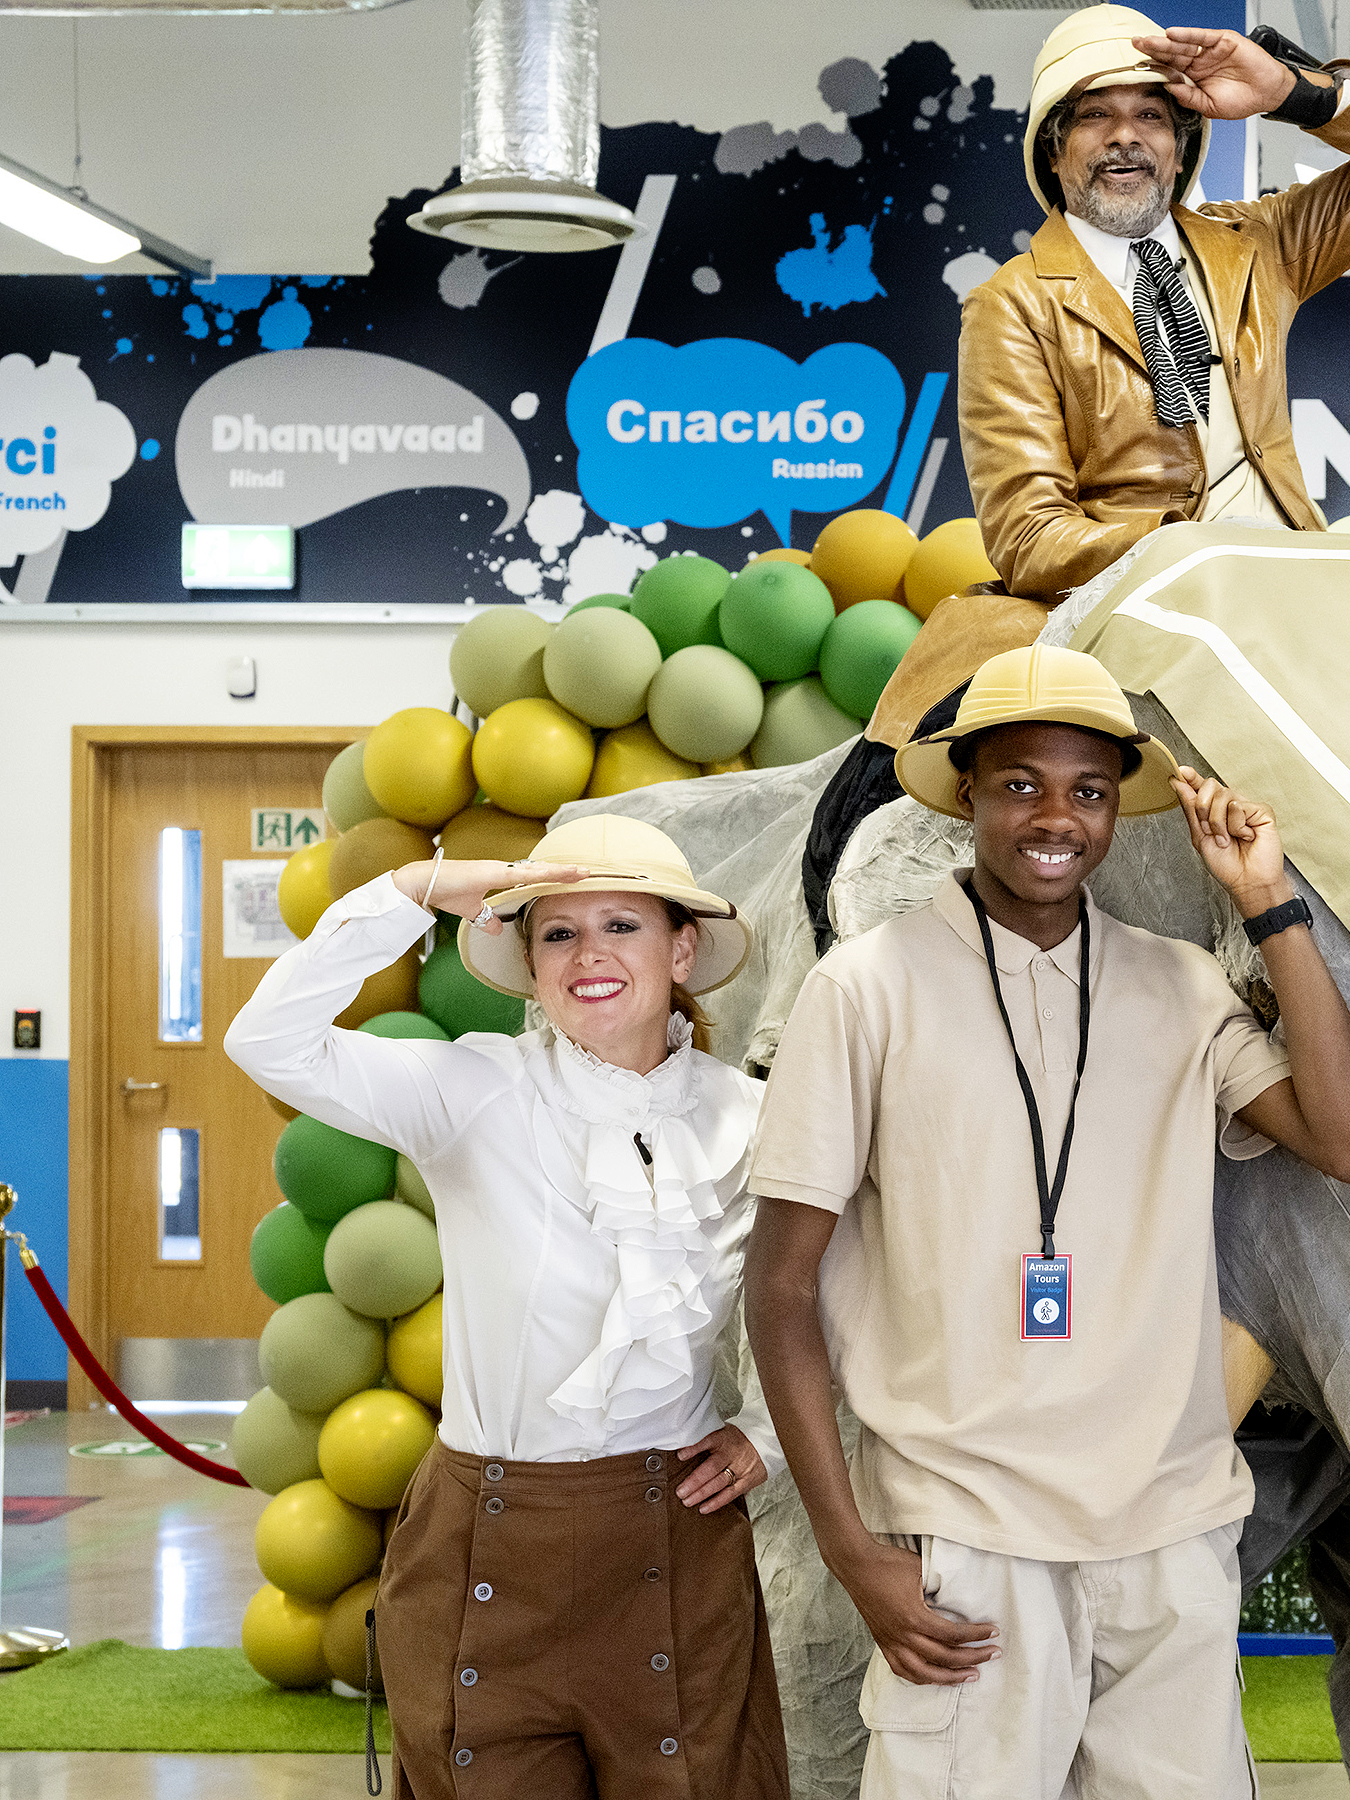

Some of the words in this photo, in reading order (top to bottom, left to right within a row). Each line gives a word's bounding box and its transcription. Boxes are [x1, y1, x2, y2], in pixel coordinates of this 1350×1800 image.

[606, 399, 865, 443] Спасибо
[212, 414, 486, 464] Dhanyavaad
[0, 425, 57, 475] ci
[229, 468, 285, 489] Hindi
[772, 459, 864, 479] Russian
[1029, 1263, 1065, 1272] Amazon
[1034, 1275, 1060, 1283] Tours
